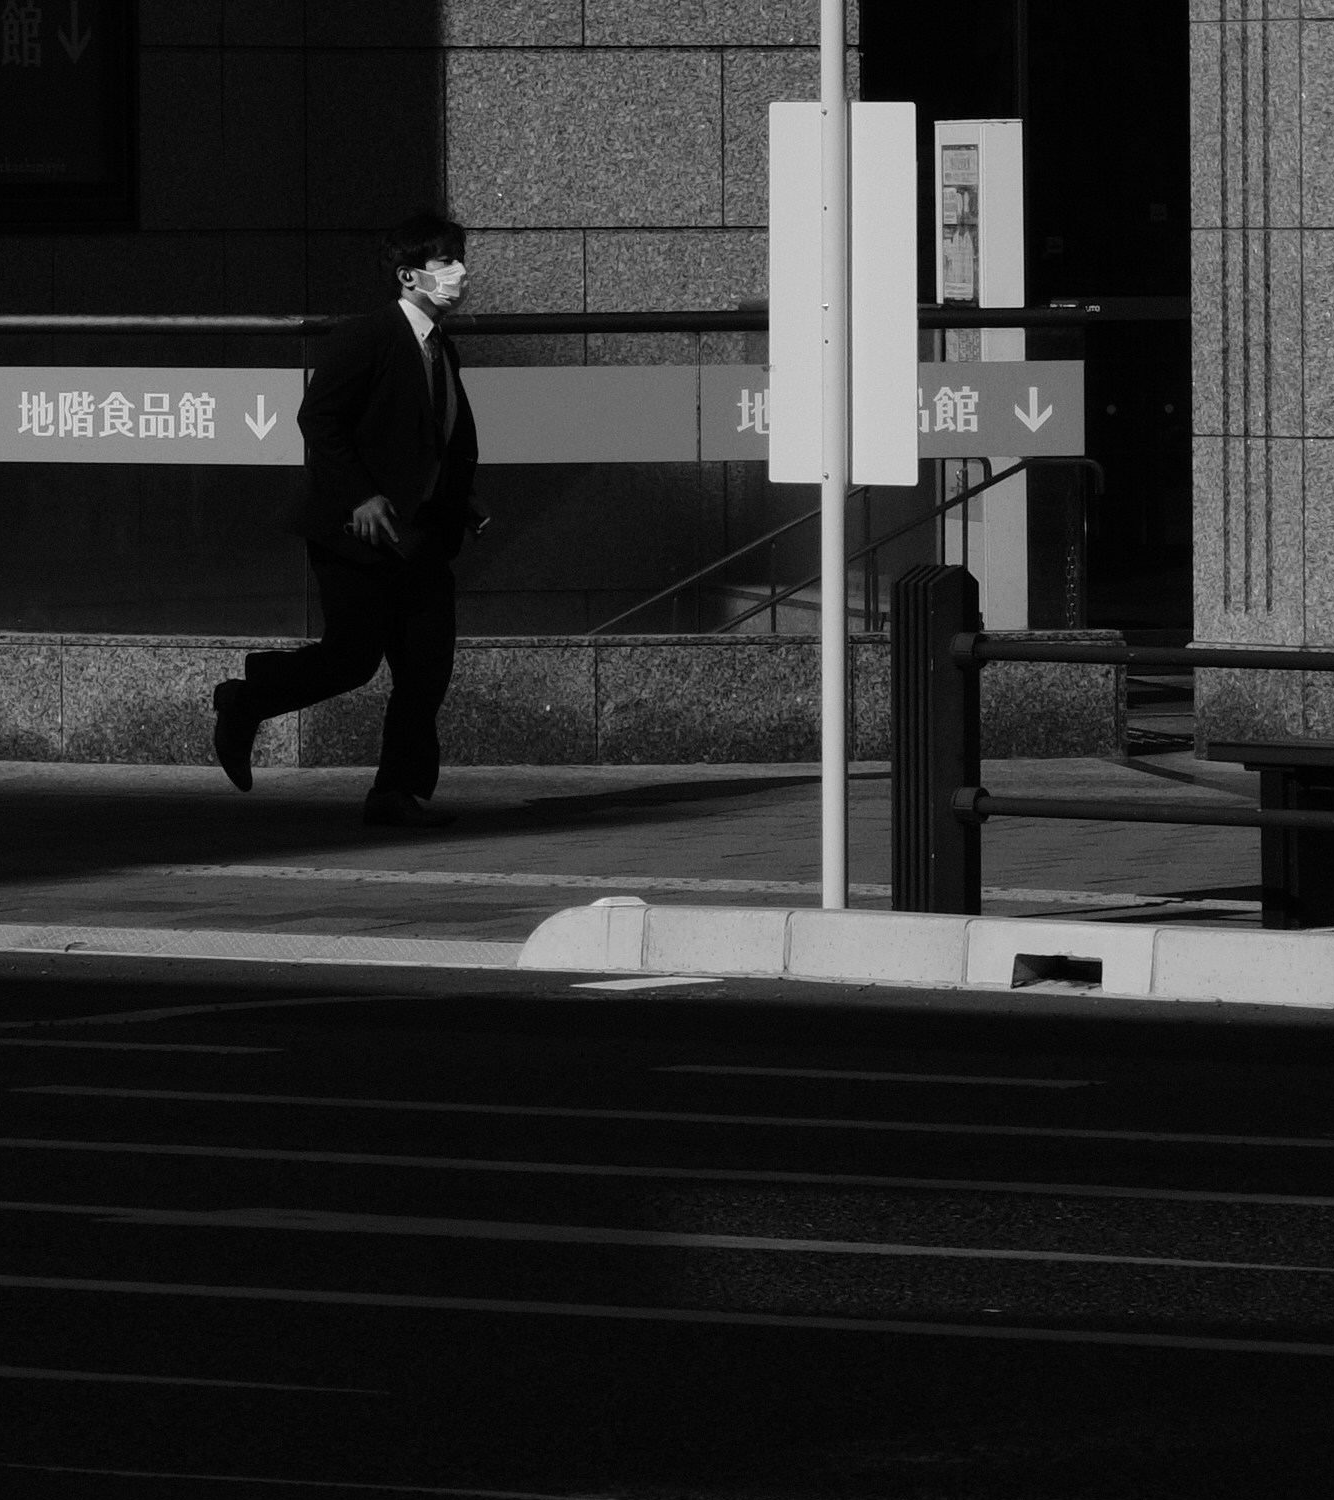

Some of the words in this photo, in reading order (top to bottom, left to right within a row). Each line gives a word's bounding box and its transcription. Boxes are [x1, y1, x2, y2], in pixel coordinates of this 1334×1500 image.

[17, 390, 216, 440] 地階食品館
